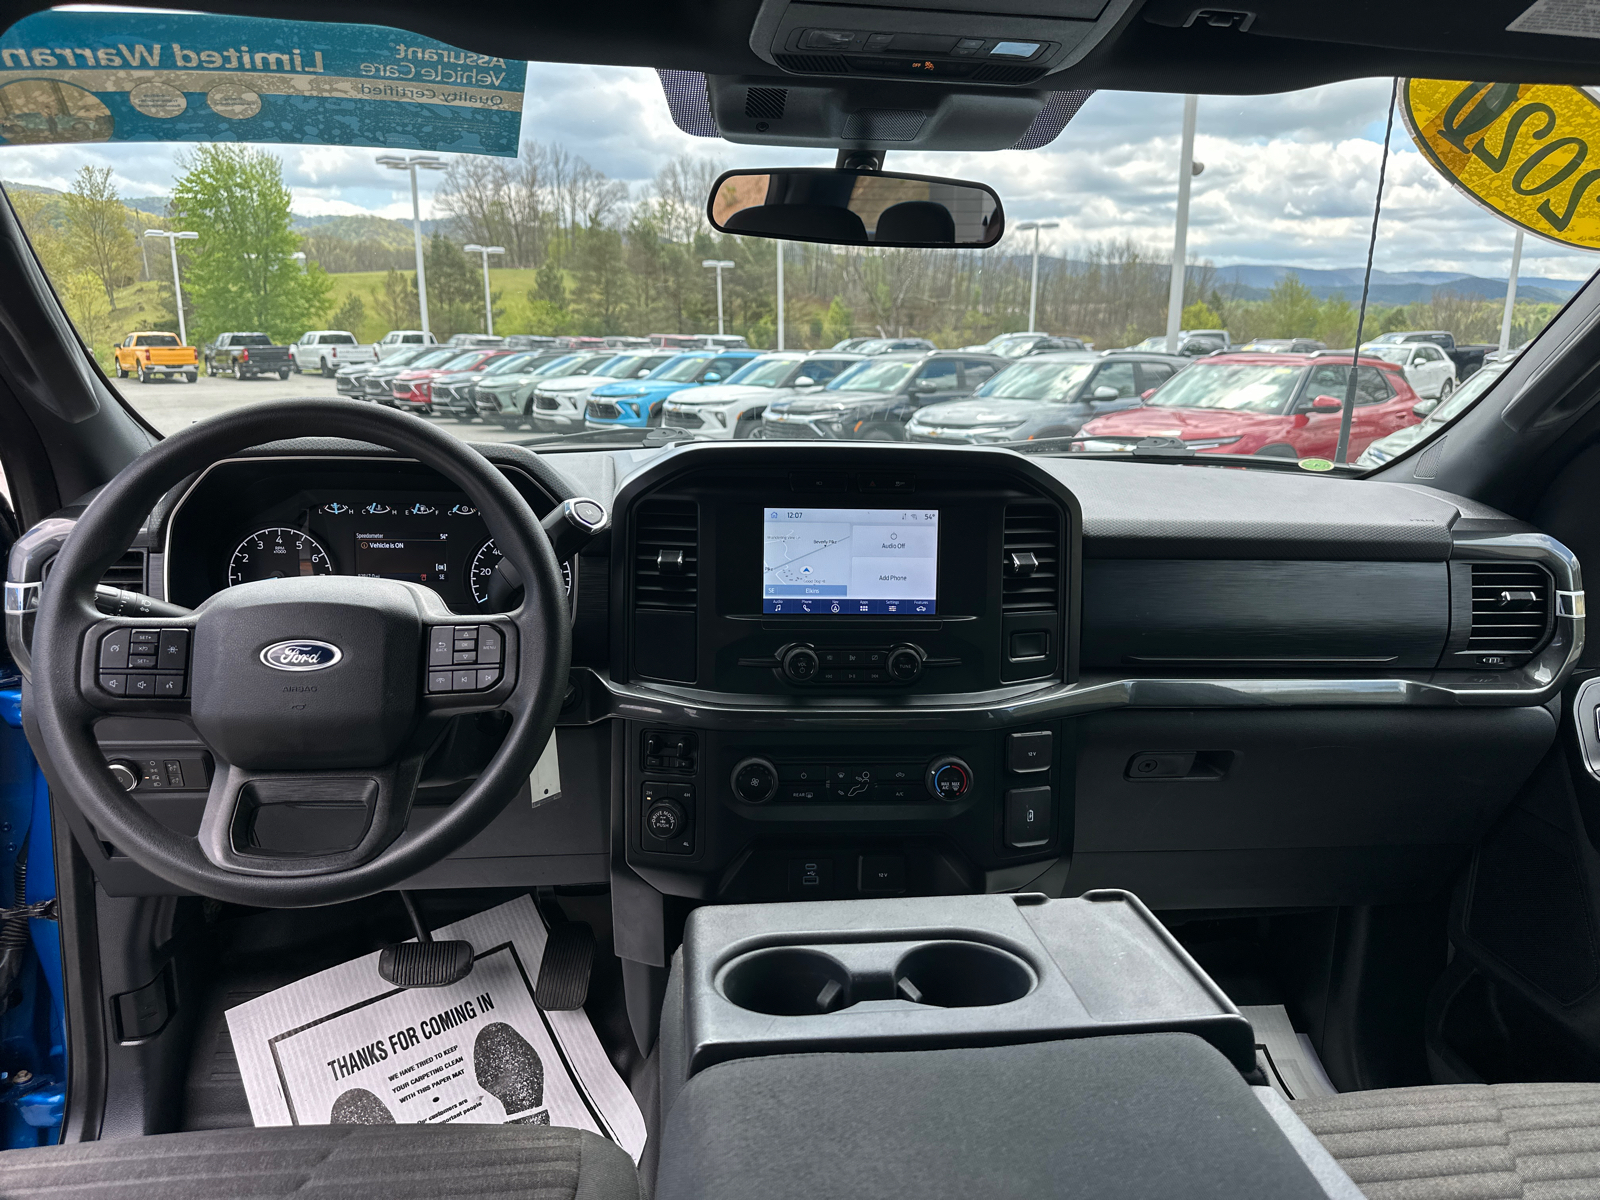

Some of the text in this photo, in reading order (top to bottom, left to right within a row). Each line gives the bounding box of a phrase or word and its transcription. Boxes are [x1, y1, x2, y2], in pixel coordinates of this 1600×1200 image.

[276, 535, 283, 544] 4
[257, 541, 264, 550] 3
[296, 541, 303, 550] 5
[242, 553, 249, 562] 2
[311, 554, 319, 563] 6
[480, 567, 492, 576] 20
[889, 574, 907, 582] Phone
[280, 646, 322, 664] Ford
[327, 992, 495, 1082] THANKS FOR COMING IN
[388, 1044, 459, 1082] WE HAVE TRIED TO KEEP
[392, 1056, 464, 1094] YOUR CARPETING CLEAN
[399, 1068, 465, 1104] WITH THIS PAPER MAT
[428, 1103, 458, 1121] customers
[458, 1098, 468, 1106] are
[463, 1101, 483, 1115] people
